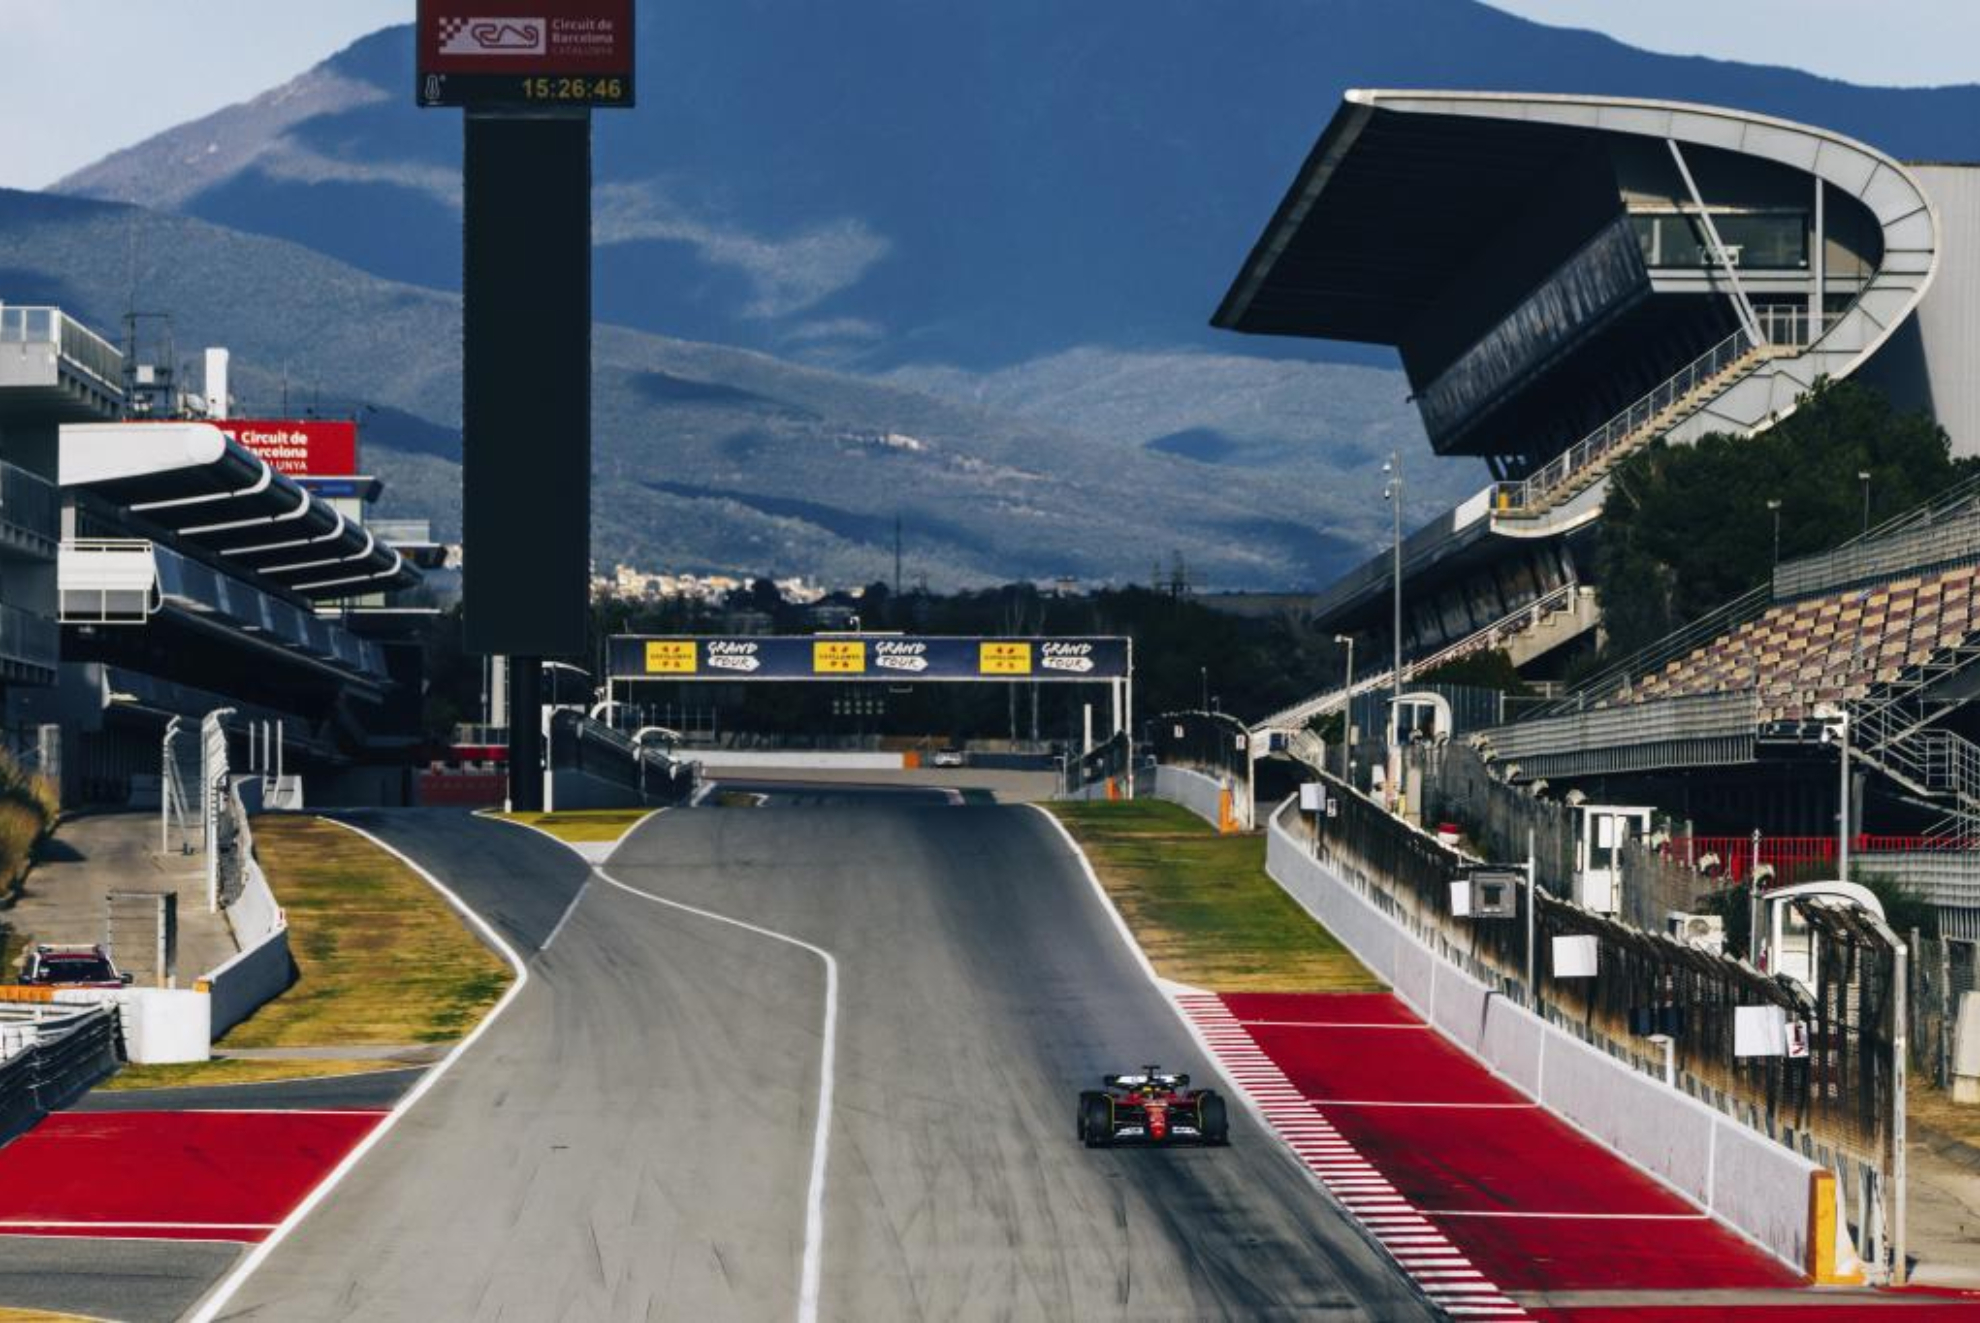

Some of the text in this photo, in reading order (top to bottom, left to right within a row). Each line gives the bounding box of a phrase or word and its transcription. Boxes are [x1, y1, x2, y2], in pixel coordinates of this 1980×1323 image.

[552, 17, 613, 30] Circuit de
[552, 31, 613, 44] Barcelona
[523, 78, 622, 98] 15:26:46
[241, 430, 308, 445] Circuit de
[708, 641, 758, 655] GRAND
[875, 641, 925, 655] GRAND
[1042, 642, 1092, 656] GRAND
[713, 656, 750, 668] TOUR
[882, 656, 919, 668] TOUR
[1049, 657, 1086, 669] TOUR
